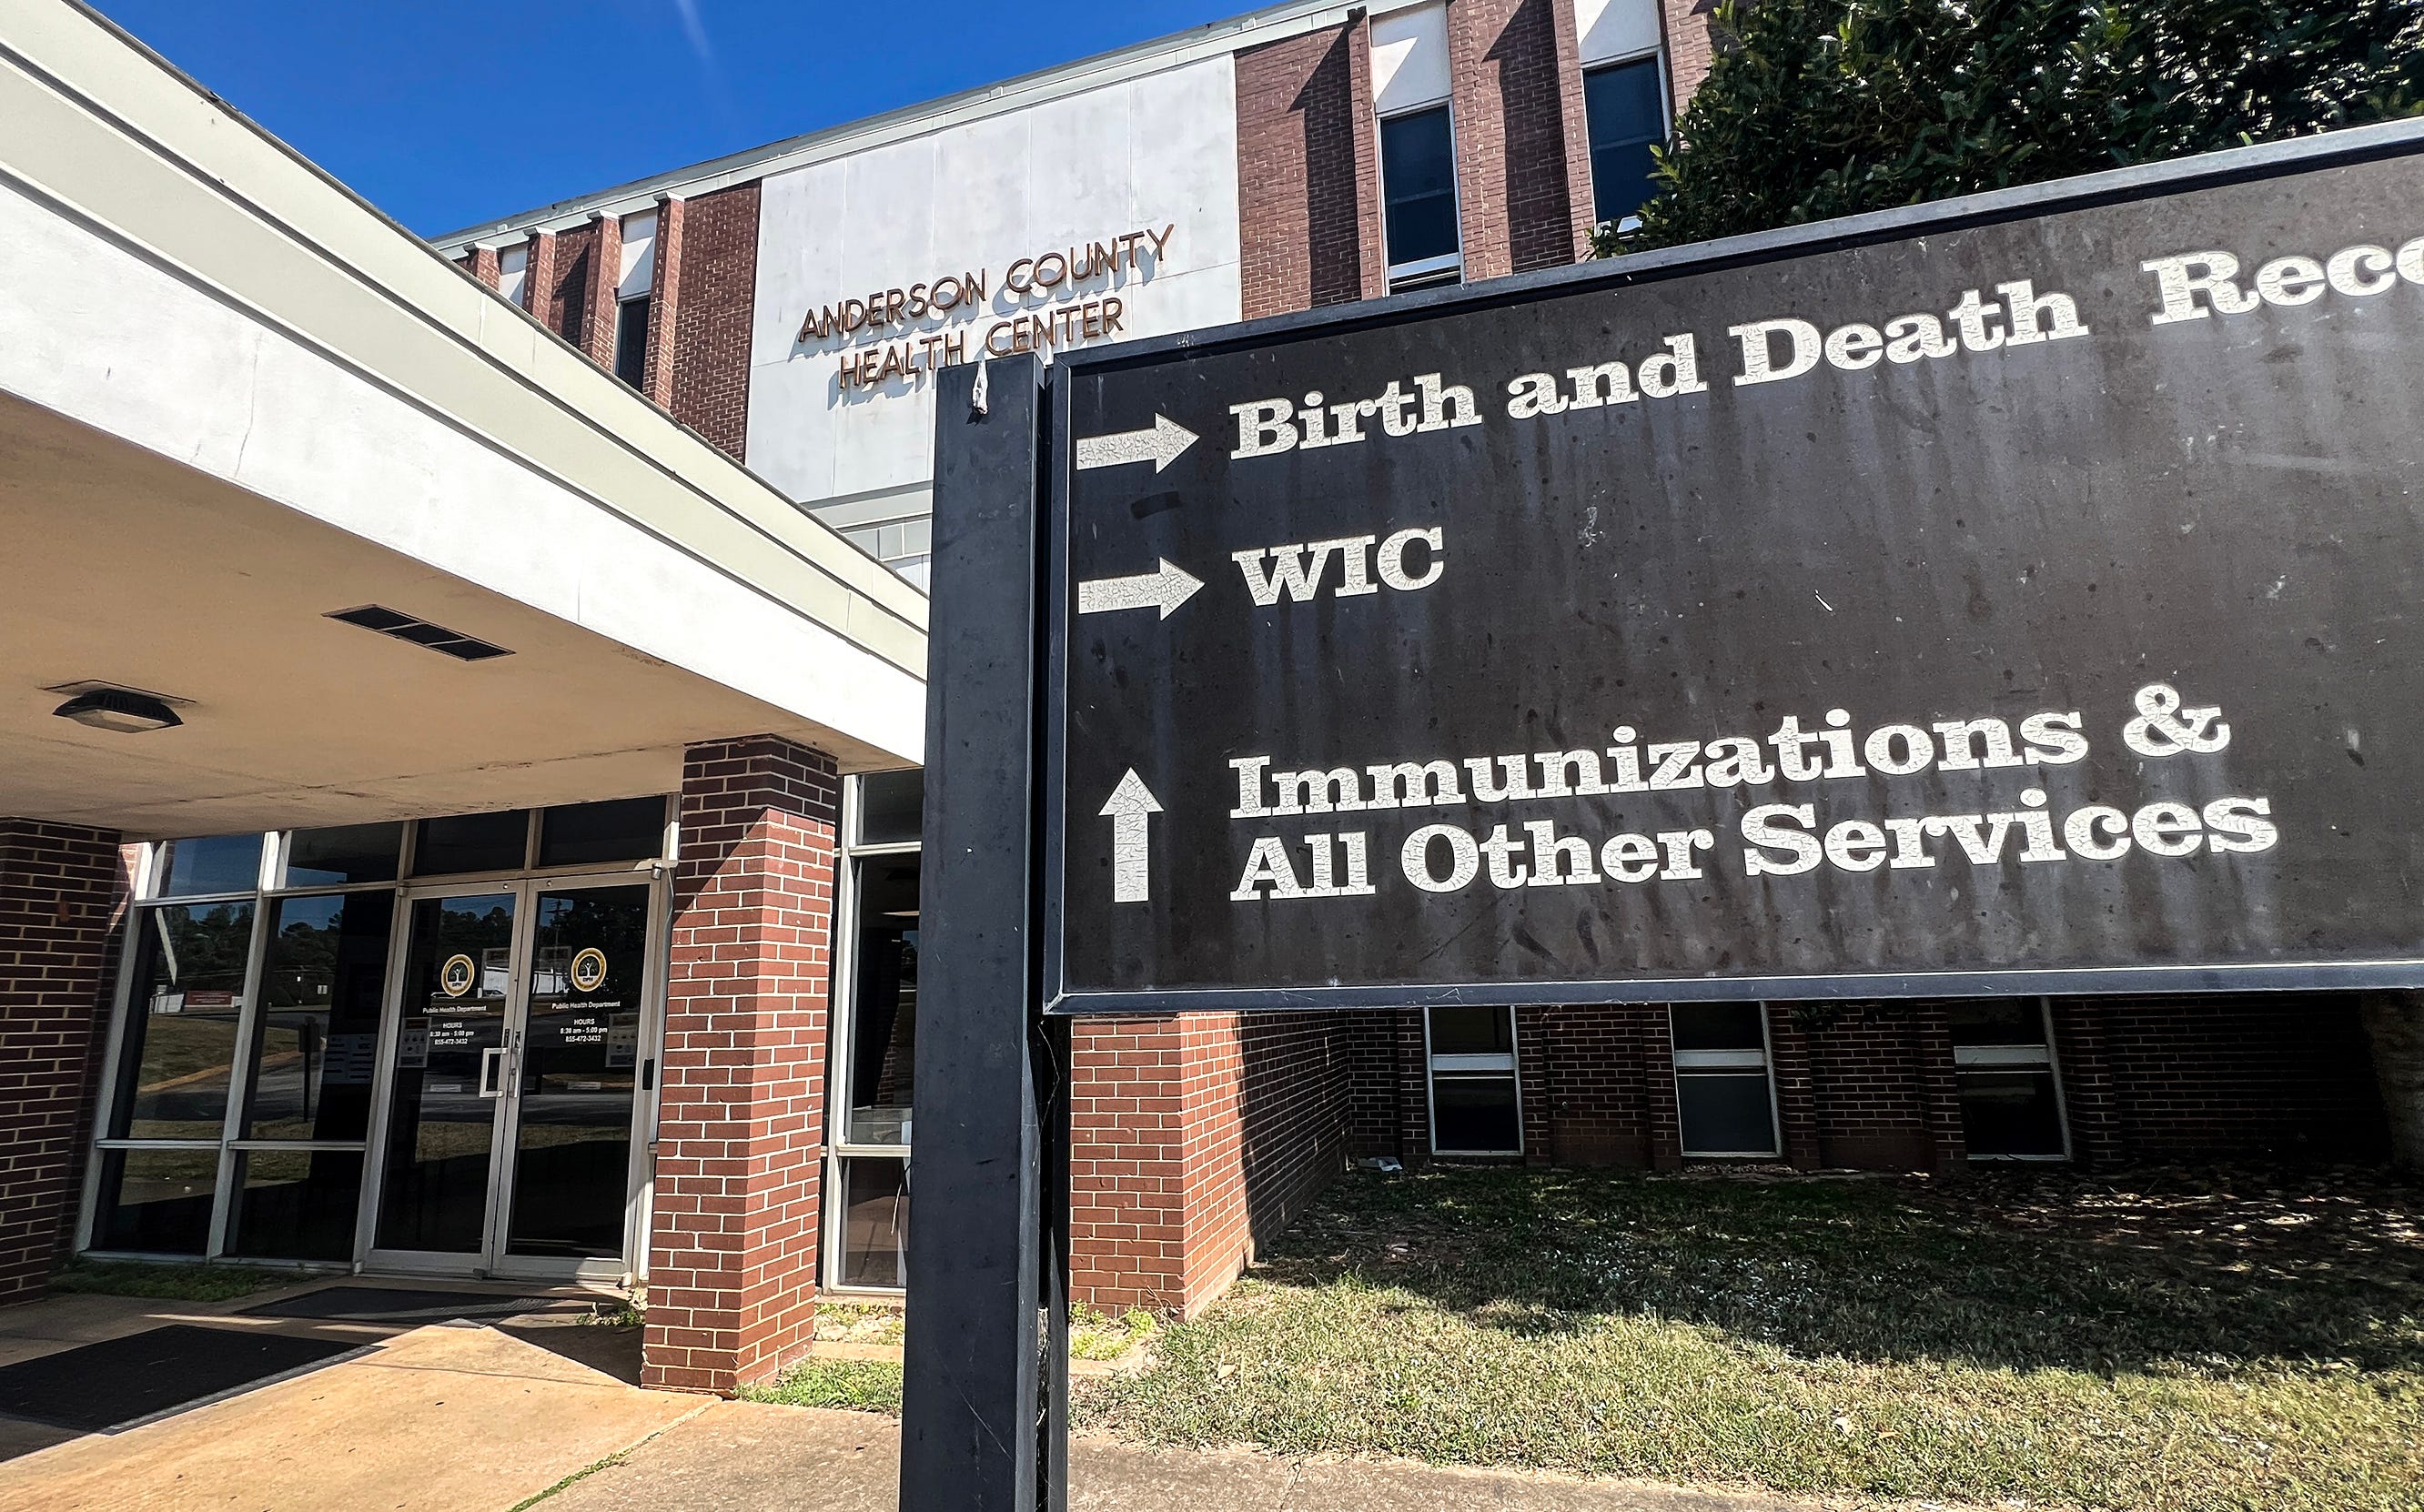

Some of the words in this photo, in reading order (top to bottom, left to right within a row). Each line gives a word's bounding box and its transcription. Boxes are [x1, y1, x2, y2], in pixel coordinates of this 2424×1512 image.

[798, 267, 986, 343] ANDERSON
[1006, 224, 1175, 293] COUNTY
[839, 329, 965, 388] HEALTH
[985, 297, 1124, 357] CENTER
[1230, 381, 1481, 459] Birth
[1508, 333, 1707, 418] and
[1731, 279, 2089, 386] Death
[1232, 527, 1443, 606] WIC
[1229, 709, 2088, 818] Immunizations
[2124, 684, 2230, 756] &
[1230, 832, 1375, 901] All
[1401, 820, 1713, 892] Other
[1742, 788, 2278, 875] Services
[589, 1001, 621, 1009] Department
